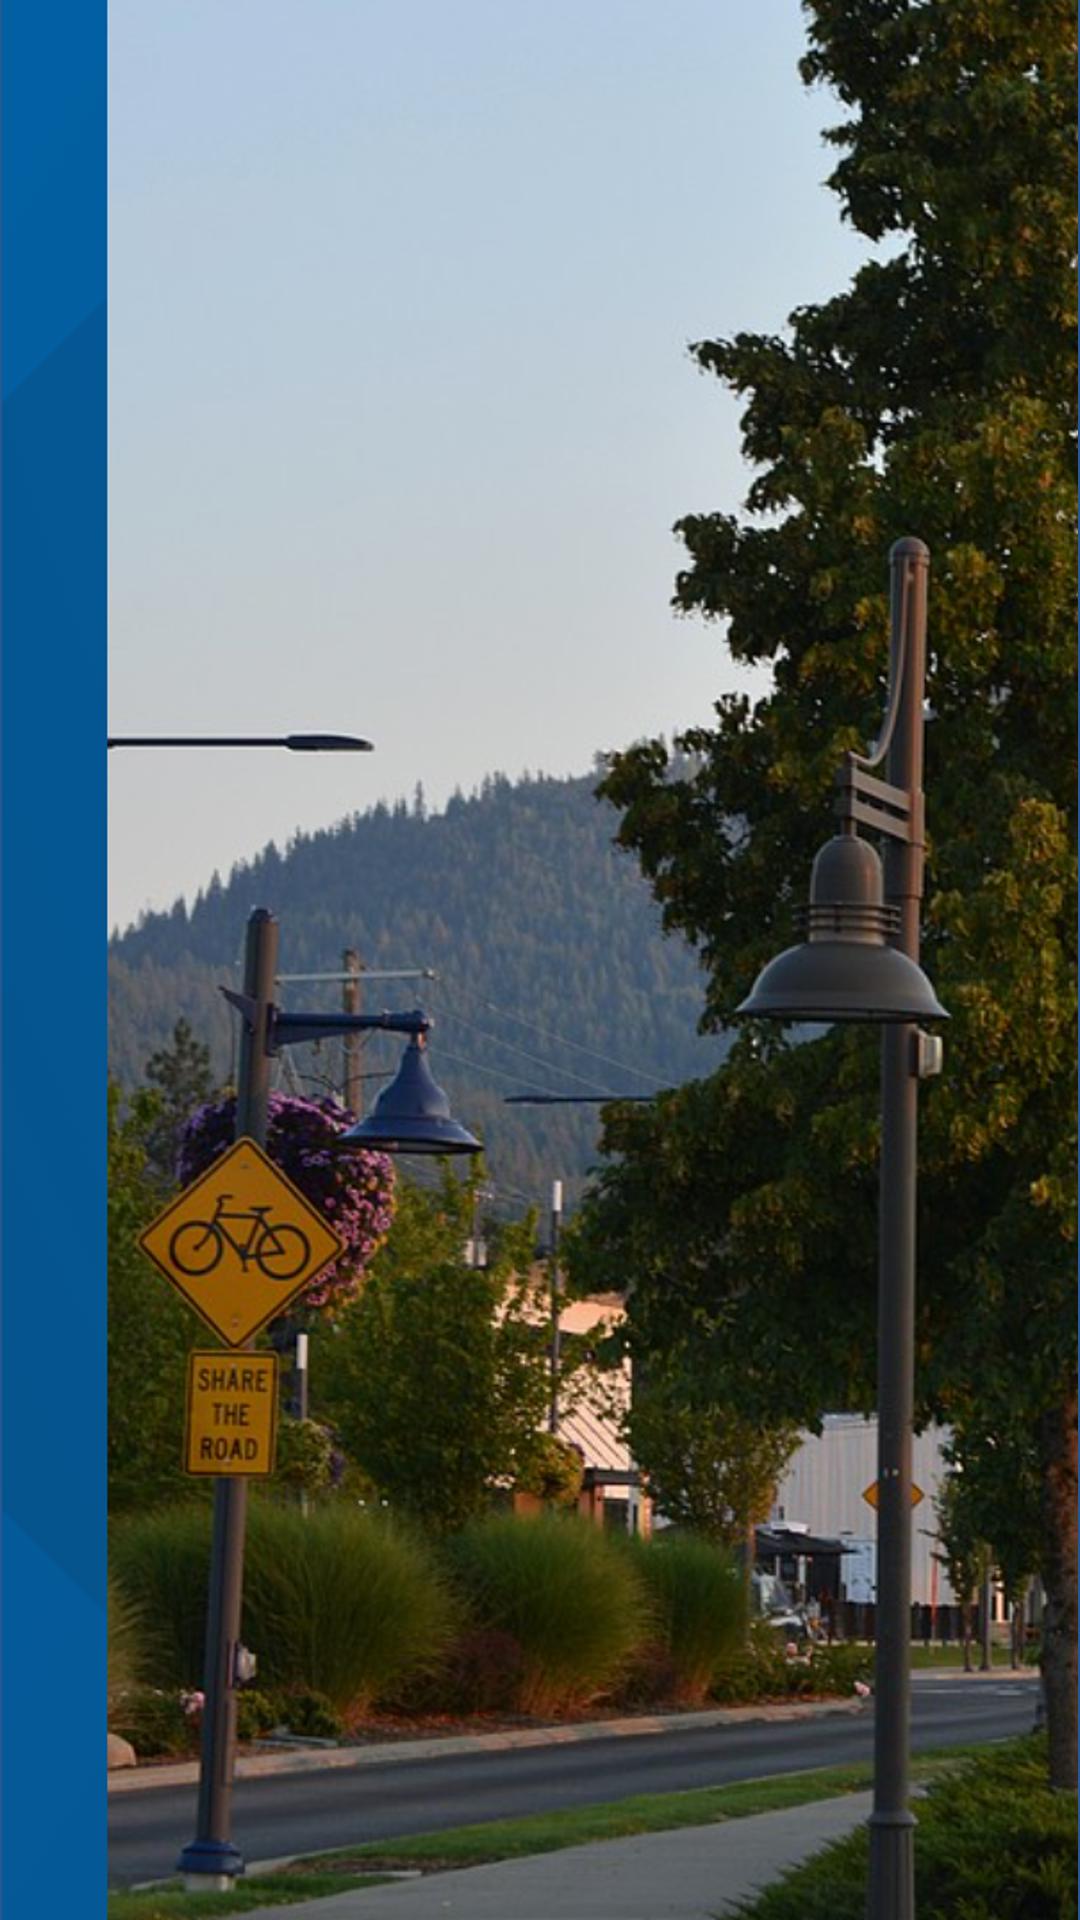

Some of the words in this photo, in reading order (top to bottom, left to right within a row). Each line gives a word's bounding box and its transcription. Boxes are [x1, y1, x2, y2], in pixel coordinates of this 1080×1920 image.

[198, 1368, 268, 1392] SHARE
[212, 1402, 250, 1426] THE
[200, 1437, 258, 1460] ROAD
